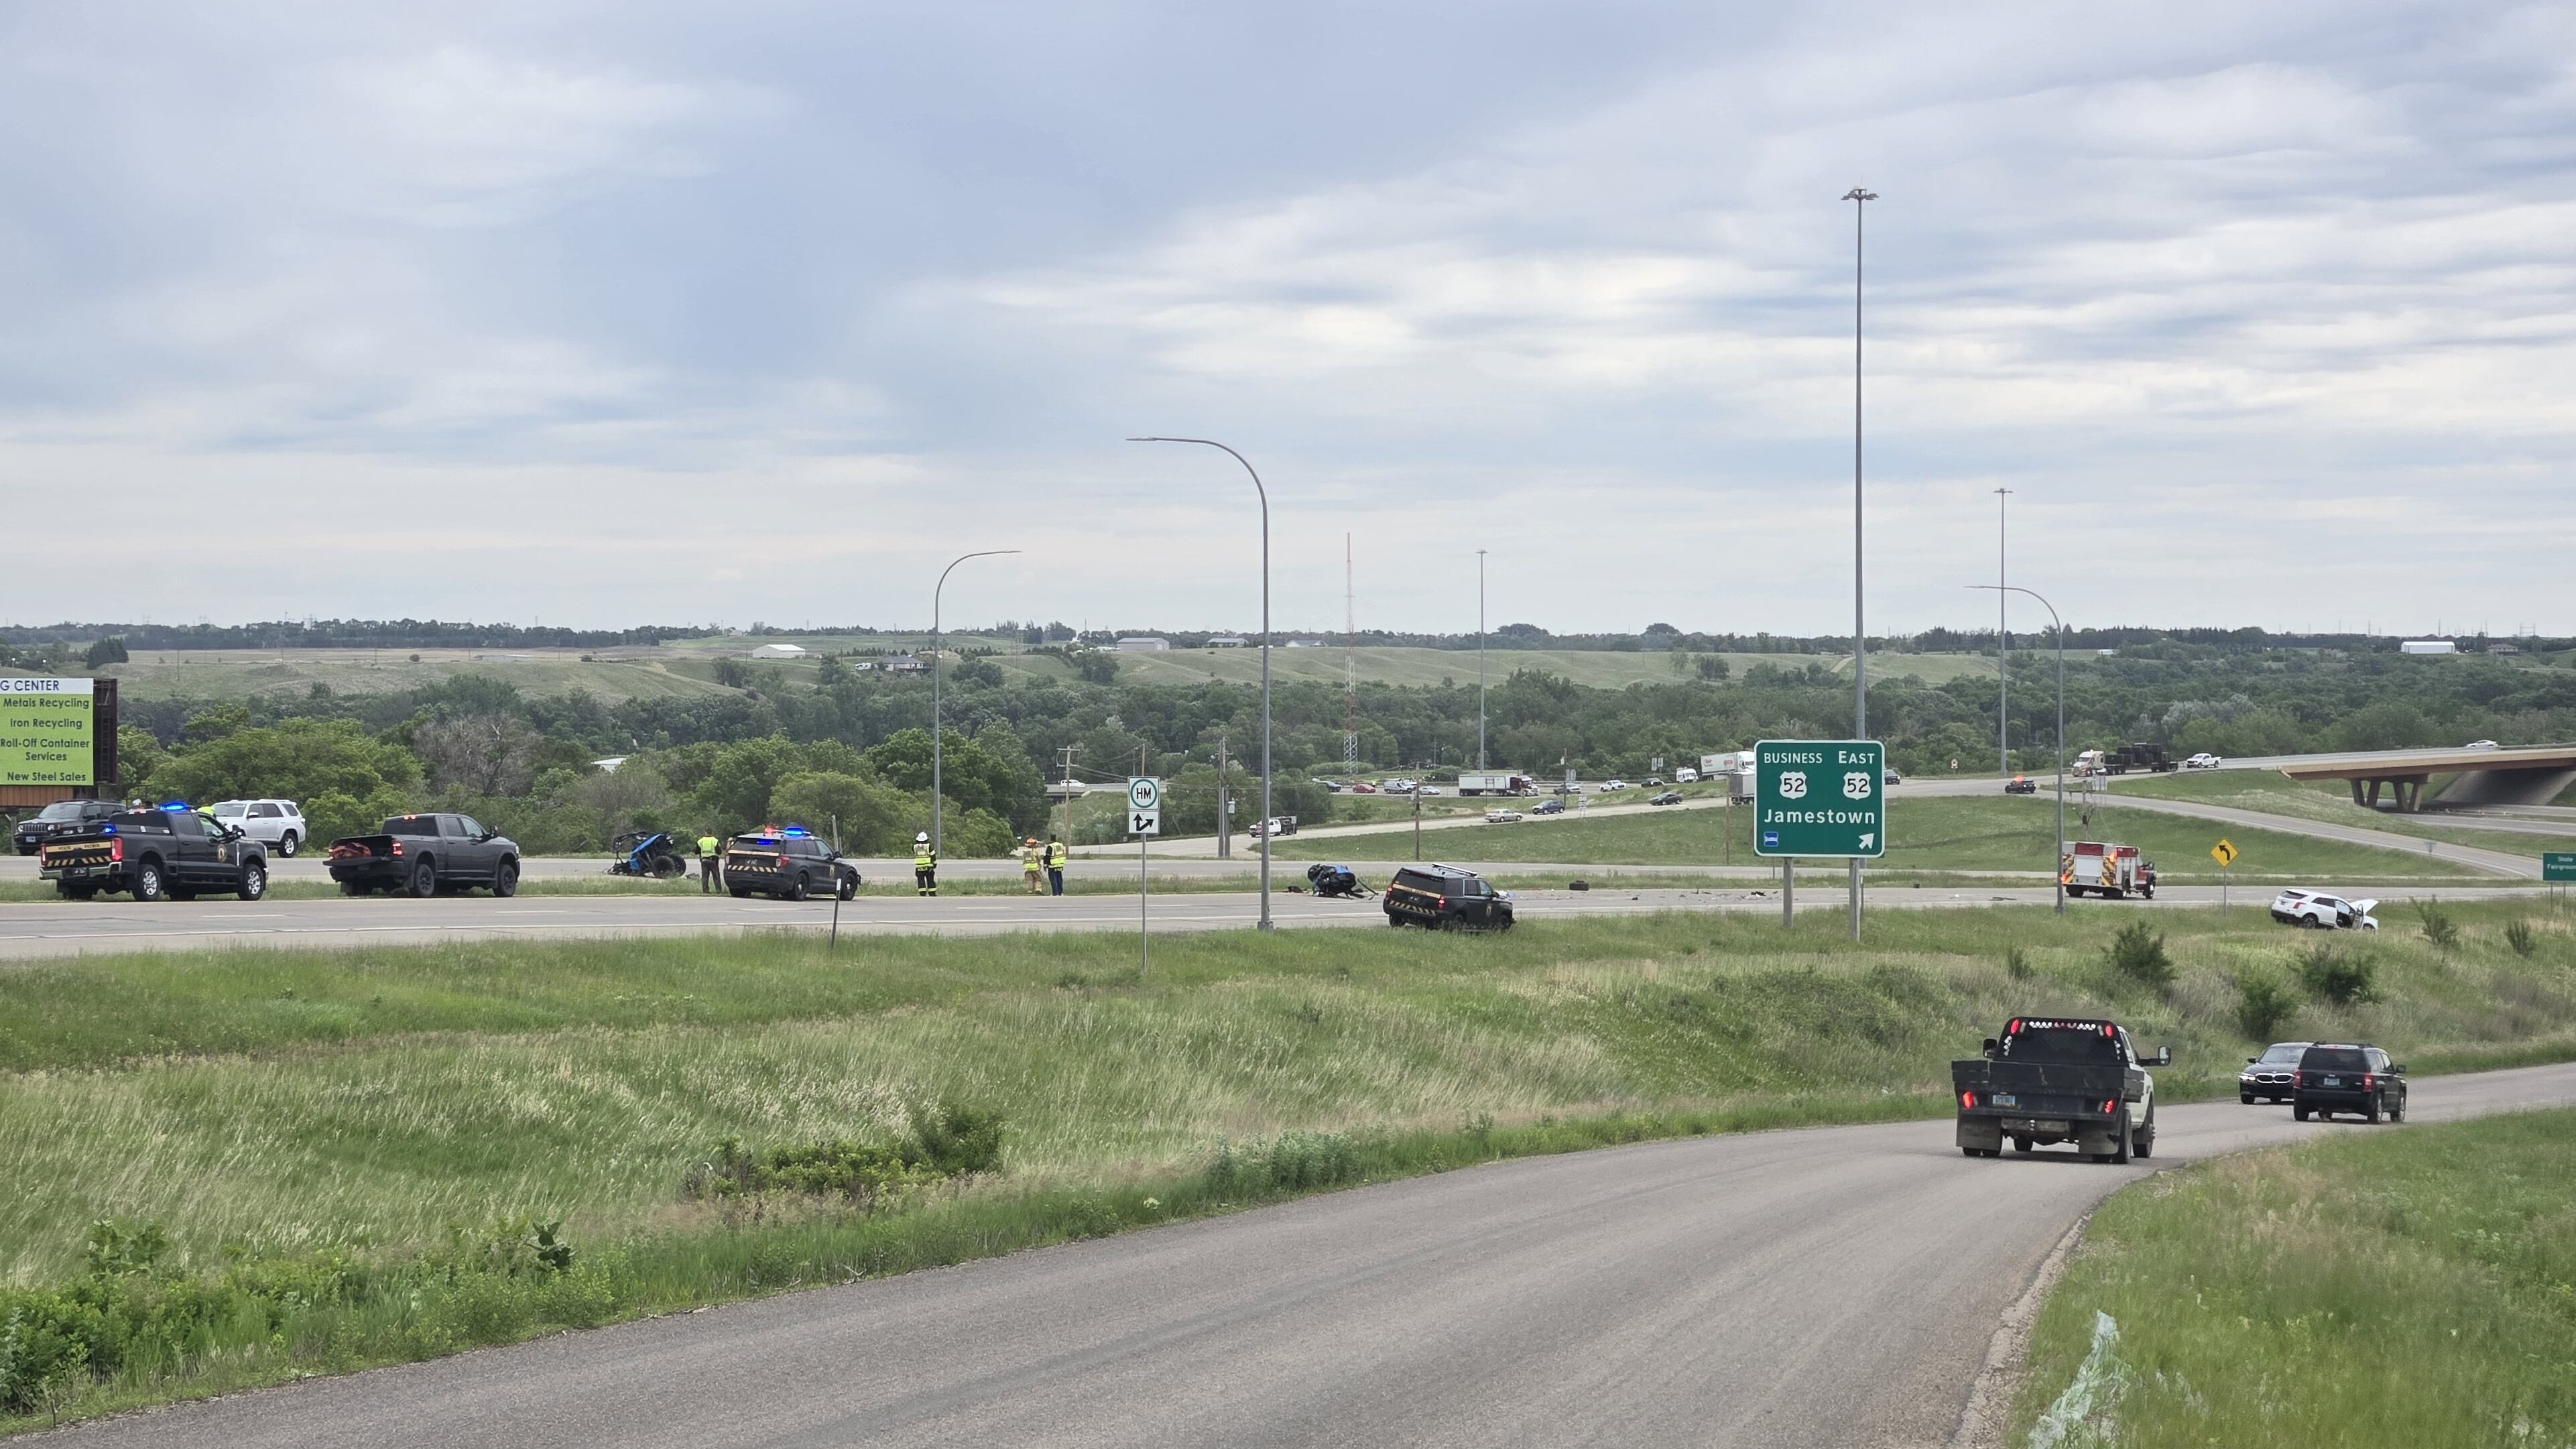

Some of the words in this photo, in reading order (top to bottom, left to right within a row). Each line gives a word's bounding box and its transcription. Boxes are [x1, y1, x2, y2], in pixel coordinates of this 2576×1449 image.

[14, 680, 60, 691] CENTER
[3, 698, 36, 707] Metals
[40, 698, 89, 709] Recycling
[10, 718, 29, 728] Iron
[33, 718, 82, 730] Recycling
[0, 738, 37, 748] Roll-Off
[40, 738, 90, 748] Container
[25, 752, 67, 761] Services
[1764, 752, 1823, 764] BUSINESS
[1838, 750, 1875, 764] EAST
[7, 772, 29, 780] New
[32, 772, 57, 781] Steel
[60, 772, 86, 782] Sales
[1783, 777, 1804, 793] 52
[1847, 778, 1868, 793] 52
[1136, 787, 1152, 799] HM
[1764, 809, 1875, 824] Jamestown
